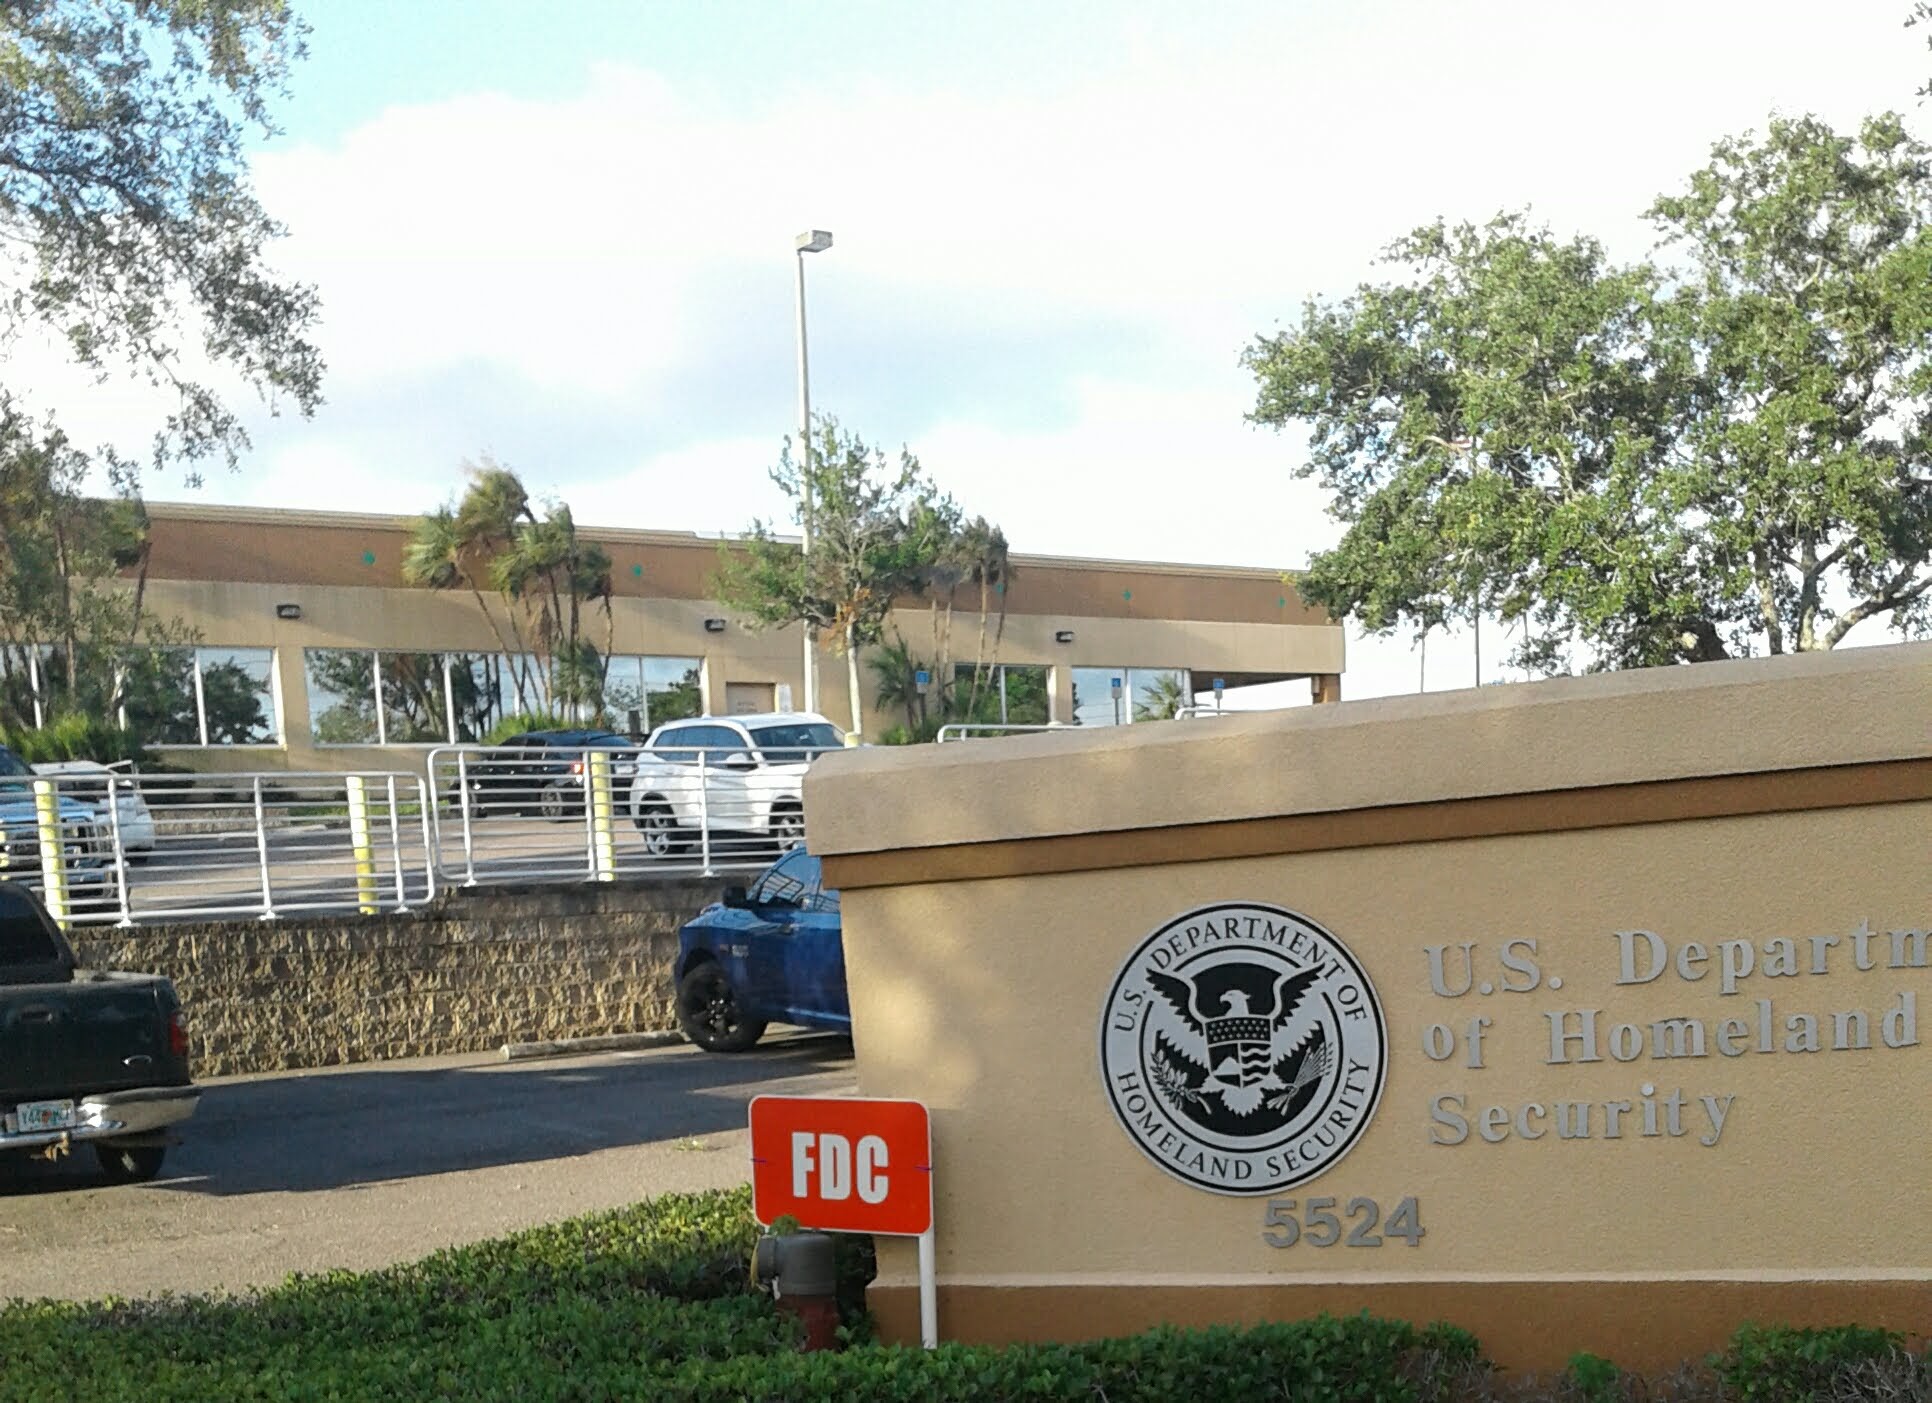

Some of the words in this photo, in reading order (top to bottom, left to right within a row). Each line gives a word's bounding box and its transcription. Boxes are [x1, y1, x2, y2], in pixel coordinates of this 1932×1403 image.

[1115, 988, 1147, 1032] U.S.
[1150, 916, 1346, 983] DEPARTMENT
[1338, 984, 1367, 1021] OF
[1425, 937, 1564, 998] U.S.
[1421, 1013, 1492, 1069] of
[1544, 992, 1920, 1066] Homeland
[1117, 1070, 1252, 1180] HOMELAND
[1267, 1059, 1370, 1178] SECURITY
[1428, 1082, 1736, 1147] Security
[791, 1131, 890, 1205] FDC
[1264, 1195, 1426, 1248] 5524
